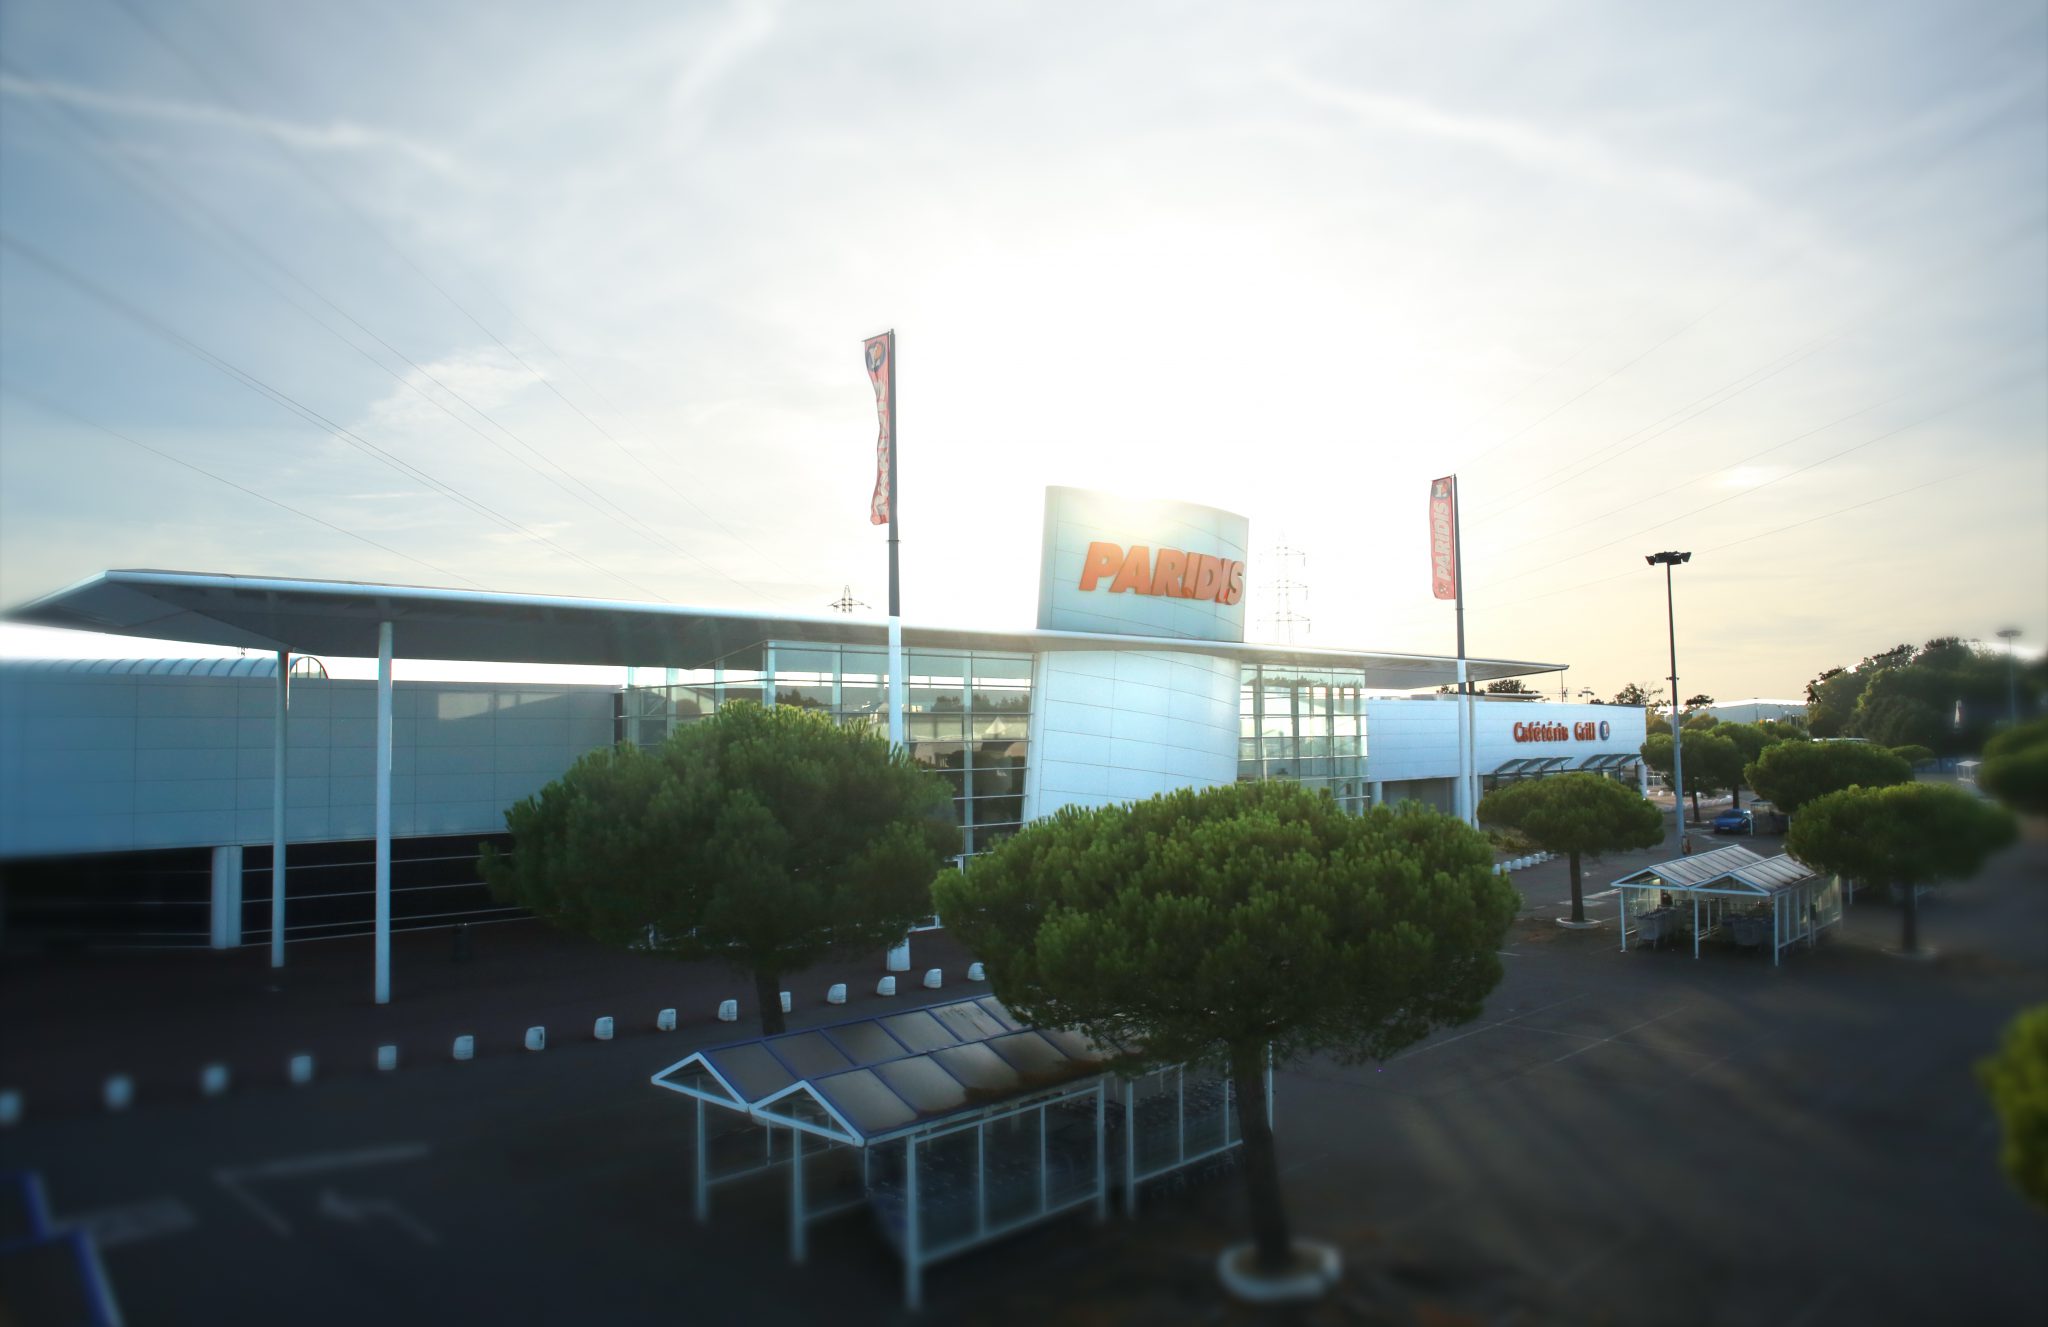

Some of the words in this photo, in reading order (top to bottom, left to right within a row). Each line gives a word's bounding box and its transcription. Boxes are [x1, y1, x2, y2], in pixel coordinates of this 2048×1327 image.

[1078, 541, 1245, 605] PARIDIS
[1434, 502, 1452, 581] PARIDIS
[1574, 722, 1596, 741] Grill
